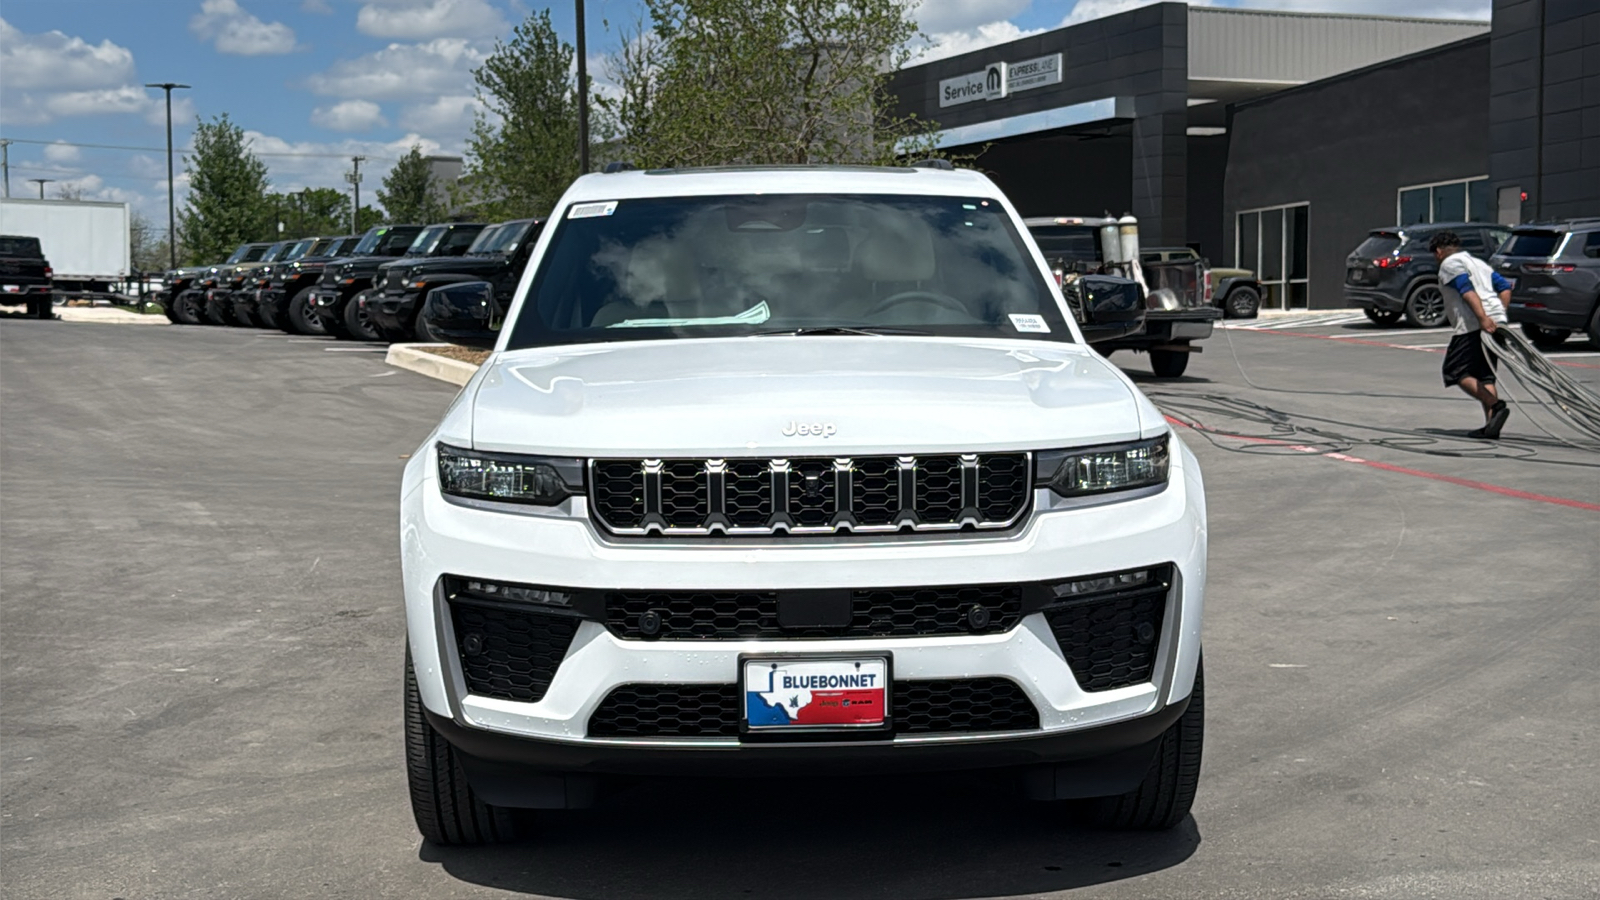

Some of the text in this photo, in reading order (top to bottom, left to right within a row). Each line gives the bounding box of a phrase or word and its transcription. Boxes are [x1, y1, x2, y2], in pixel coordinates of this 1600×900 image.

[944, 81, 983, 101] Service
[782, 420, 837, 438] Jeep
[783, 674, 876, 689] BLUEBONNET
